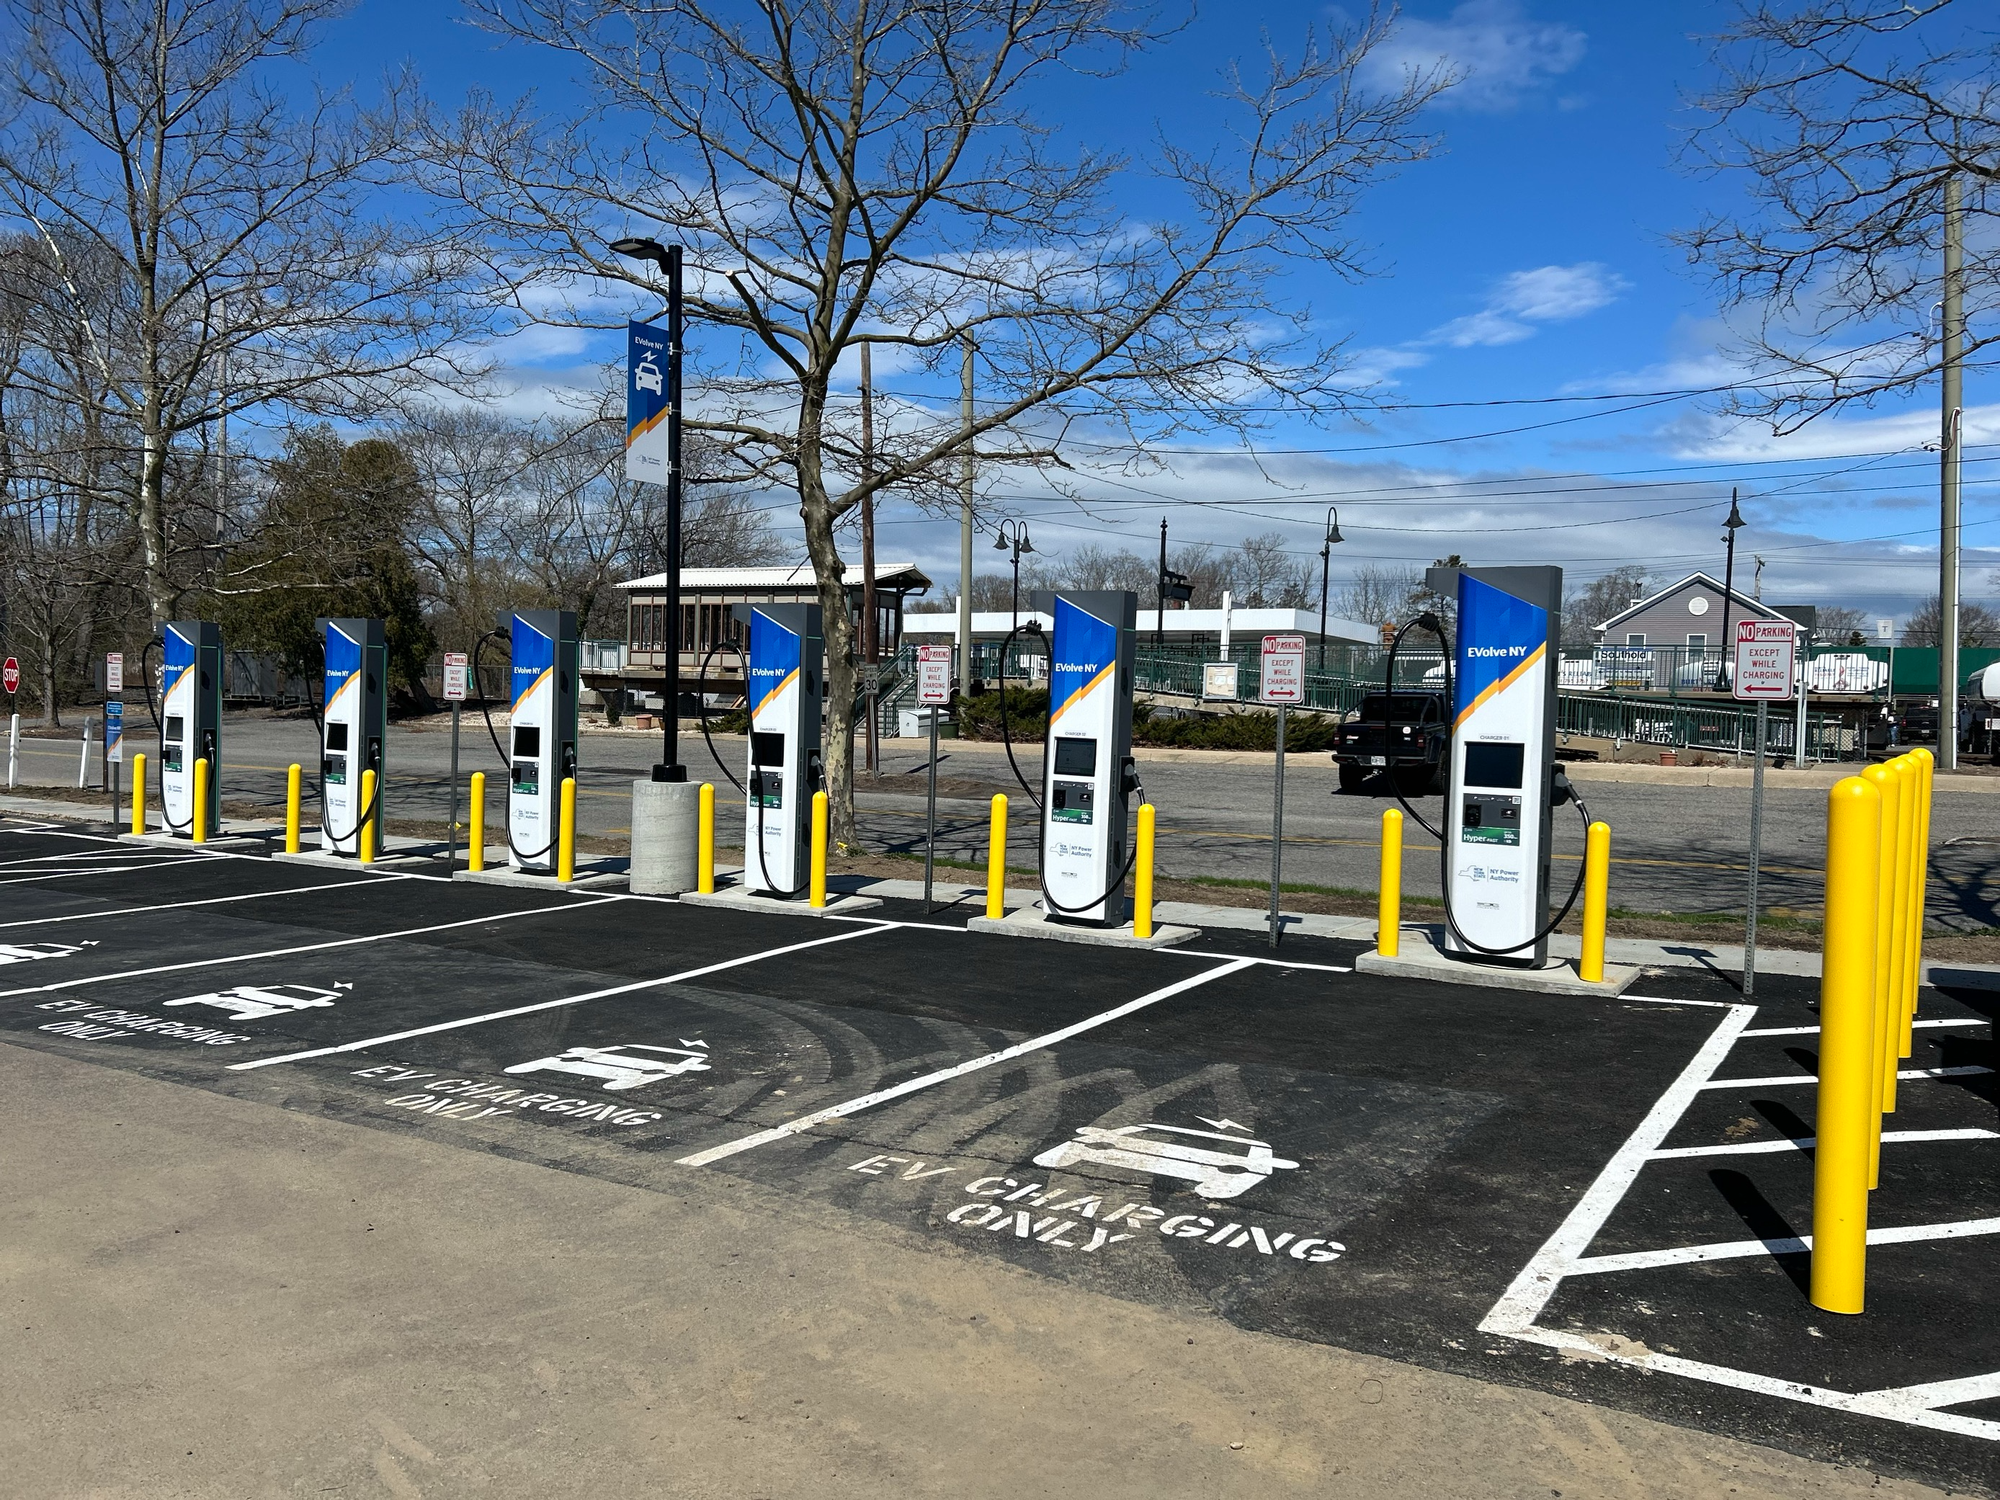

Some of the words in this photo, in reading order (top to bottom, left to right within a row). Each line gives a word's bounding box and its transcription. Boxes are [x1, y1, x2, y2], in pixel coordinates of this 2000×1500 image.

[635, 336, 654, 348] EVolve
[655, 342, 663, 350] NY
[1739, 624, 1754, 639] NO
[1756, 627, 1791, 637] PARKING
[1264, 639, 1275, 652] NO
[1276, 641, 1302, 650] PARKING
[921, 649, 929, 660] NO
[930, 650, 948, 658] PARKING
[1467, 646, 1507, 657] EVolve
[1509, 646, 1527, 656] NY
[1601, 651, 1646, 659] Southold
[1055, 663, 1083, 672] EVolve
[1084, 663, 1098, 673] NY
[1752, 660, 1777, 668] WHILE
[5, 668, 18, 682] STOP
[514, 666, 532, 674] EVolve
[752, 668, 774, 676] EVolve
[775, 668, 785, 676] NY
[1743, 671, 1784, 679] CHARGING
[866, 679, 877, 690] 30
[1463, 834, 1486, 842] Hyper
[1490, 875, 1519, 883] Authority
[35, 999, 104, 1013] EV
[83, 1009, 251, 1045] CHARGING
[37, 1021, 136, 1041] ONLY
[350, 1065, 436, 1082] EV
[423, 1078, 662, 1126] CHARGING
[384, 1094, 514, 1121] ONLY
[847, 1154, 957, 1181] EV
[965, 1175, 1347, 1263] CHARGING
[946, 1203, 1136, 1253] ONLY
